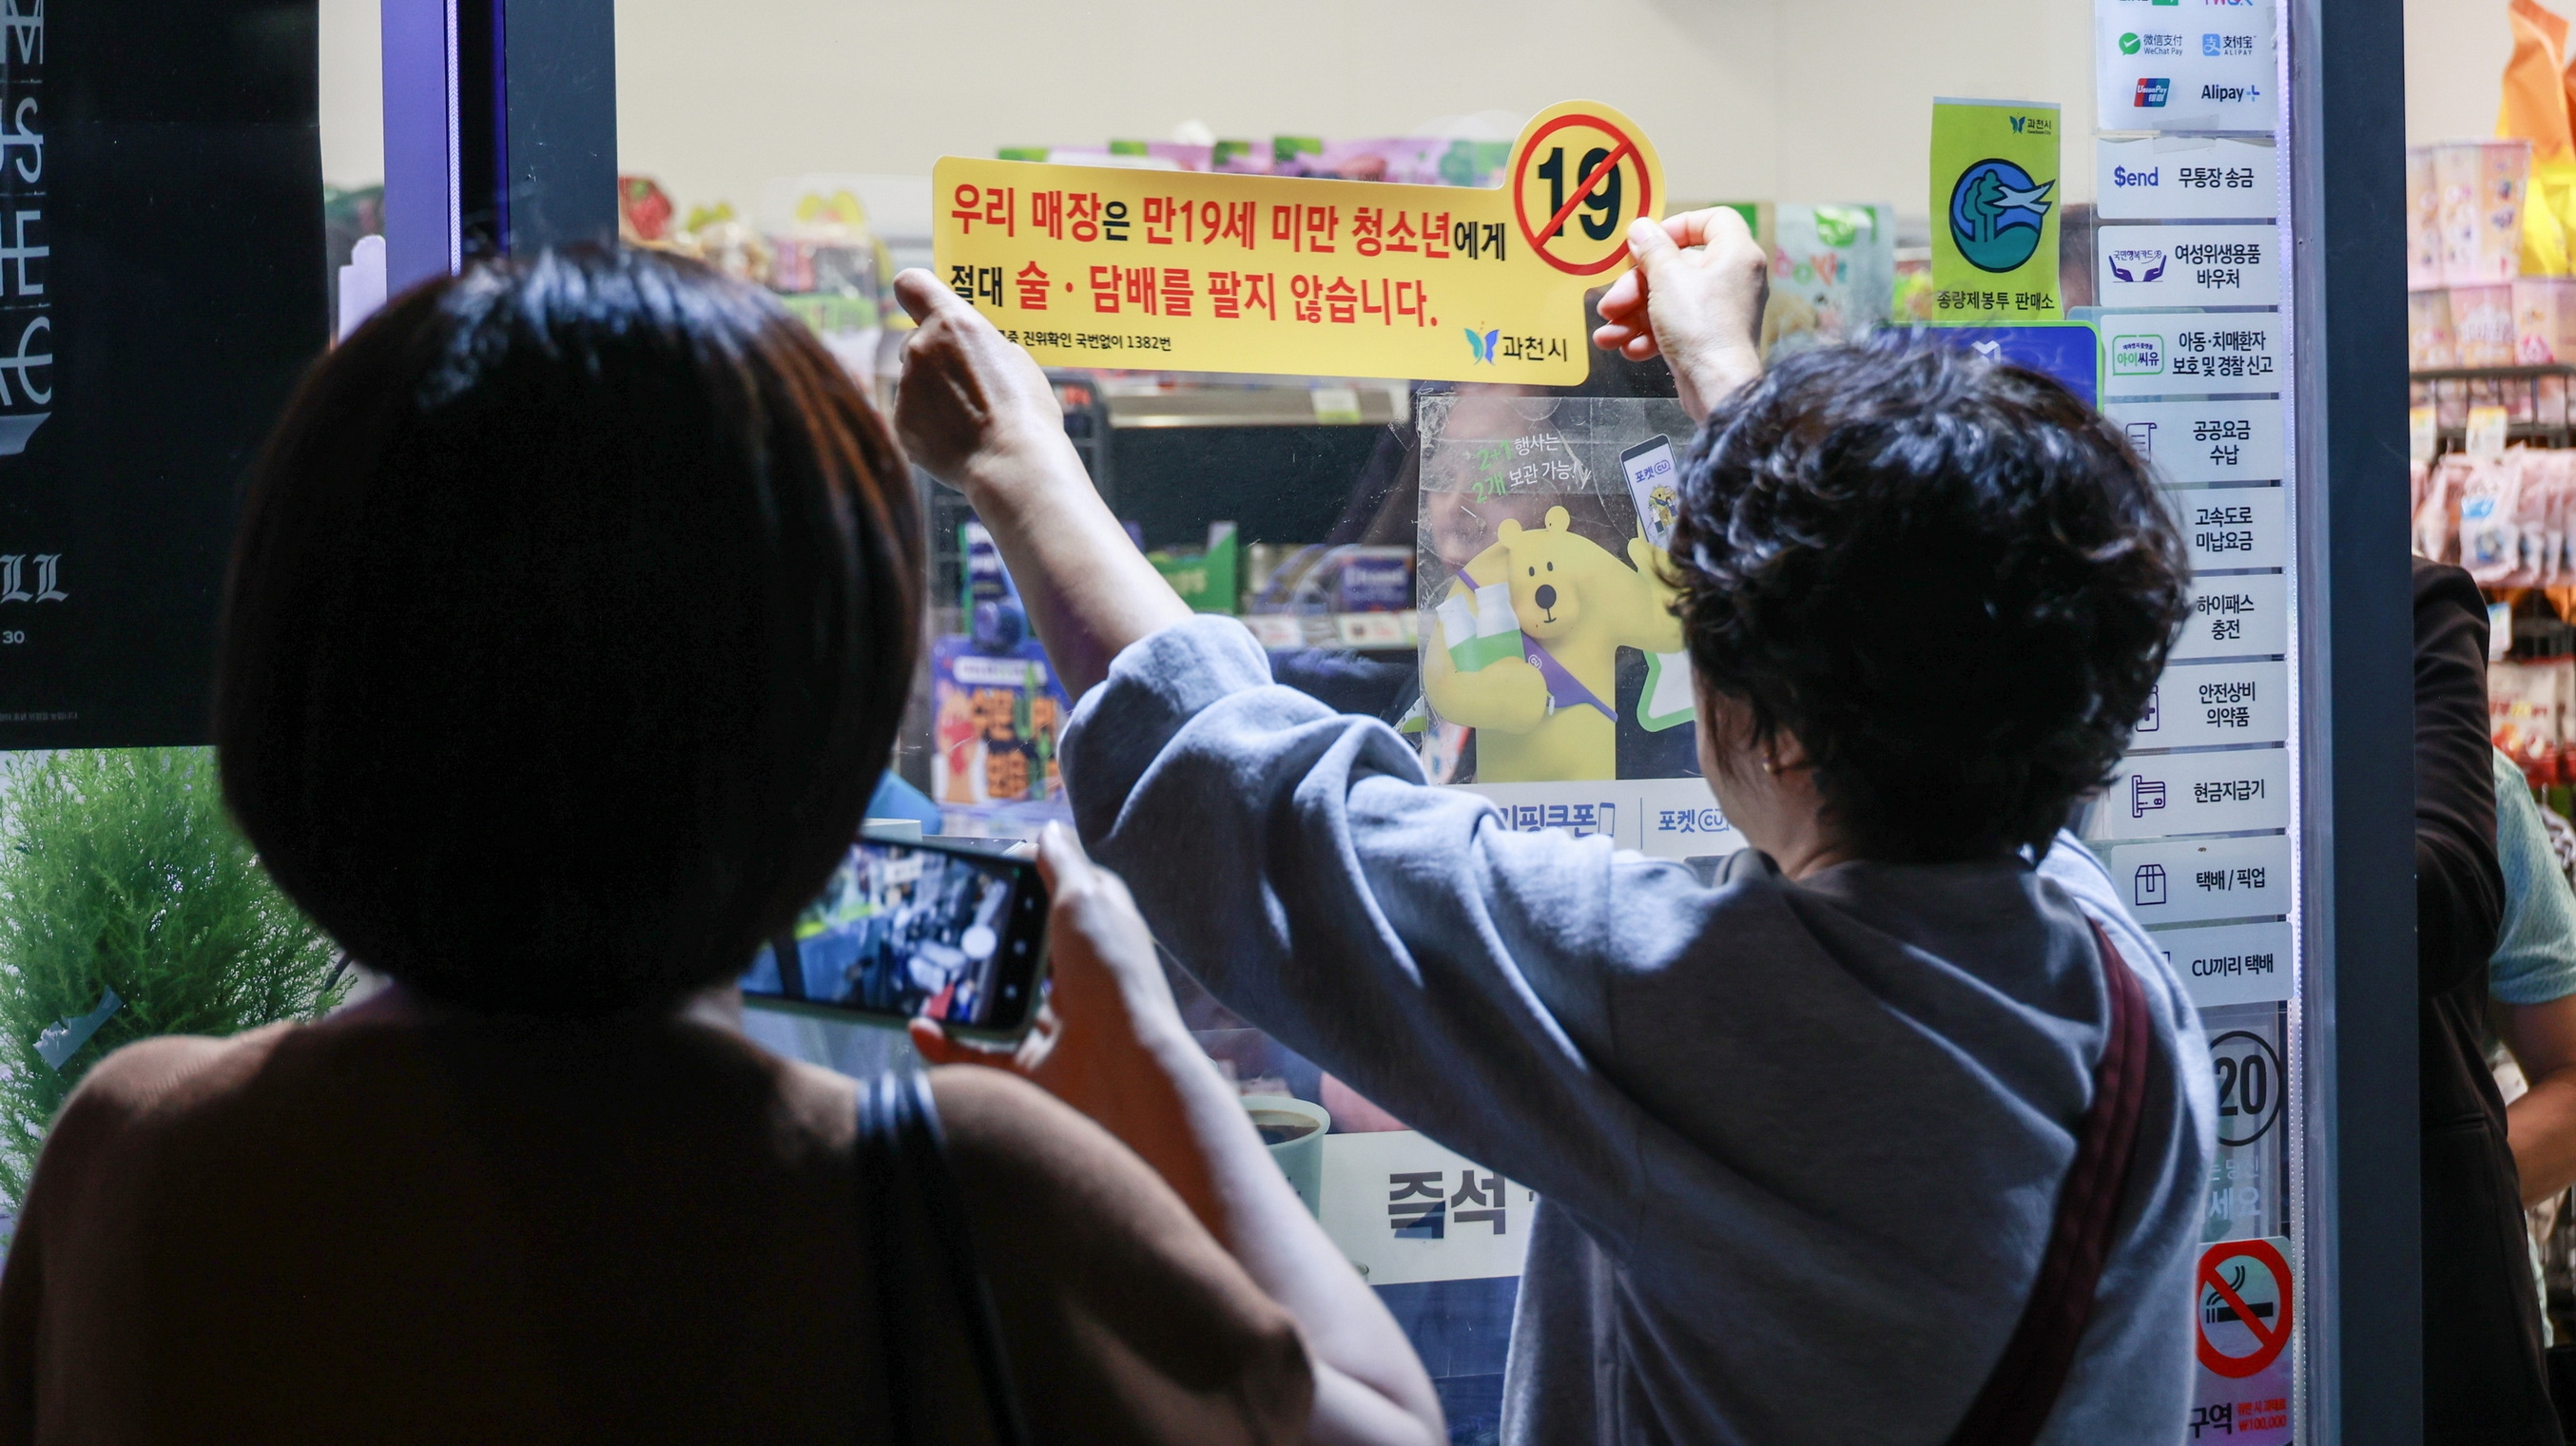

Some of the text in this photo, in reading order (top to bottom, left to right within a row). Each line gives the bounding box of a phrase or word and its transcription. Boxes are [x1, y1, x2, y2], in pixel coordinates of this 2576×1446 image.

[2143, 34, 2182, 47] 微信支付
[2223, 36, 2252, 48] 支付宝
[2171, 48, 2182, 56] Pay
[2137, 86, 2167, 96] UnionPay
[2027, 119, 2051, 129] 과천시
[2179, 166, 2254, 188] 무통장 송금
[1538, 147, 1621, 241] 19
[952, 183, 1506, 261] 우리 매장은 만19세 미만 청소년에게
[2176, 244, 2260, 265] 여성위생용품
[2197, 269, 2239, 289] 바우처
[950, 265, 1003, 307] 절대
[1016, 260, 1050, 311] 술
[1090, 265, 1194, 317] 담배를
[1208, 271, 1276, 320] 팔지
[1290, 274, 1438, 328] 않습니다.
[1937, 291, 2055, 311] 종량제봉투 판매소
[1023, 331, 1072, 348] 진위확인
[1075, 333, 1123, 350] 국번없이
[1127, 336, 1172, 352] 1382번
[1502, 337, 1567, 362] 과천시
[2179, 331, 2266, 352] 아동·치매환자
[2118, 352, 2160, 366] 아이씨유
[2173, 355, 2273, 376] 보호 및 경찰 신고
[2193, 420, 2251, 441] 공공요금
[1476, 433, 1559, 471] 2+1 행사는
[2210, 445, 2239, 465] 수납
[1472, 471, 1507, 504] 2개
[1509, 463, 1539, 487] 보관
[2195, 507, 2253, 528] 고속도로
[2197, 530, 2253, 552] 미납요금
[2197, 594, 2255, 615] 하이패스
[3, 630, 26, 644] 30
[2212, 619, 2240, 640] 충전
[2199, 682, 2256, 704] 안전상비
[2206, 706, 2250, 728] 의약품
[2194, 779, 2265, 803] 현금지급기
[2197, 870, 2225, 892] 택배
[2237, 867, 2265, 889] 픽업
[2192, 953, 2273, 977] CU끼리 택배
[1388, 1169, 1506, 1239] 즉석
